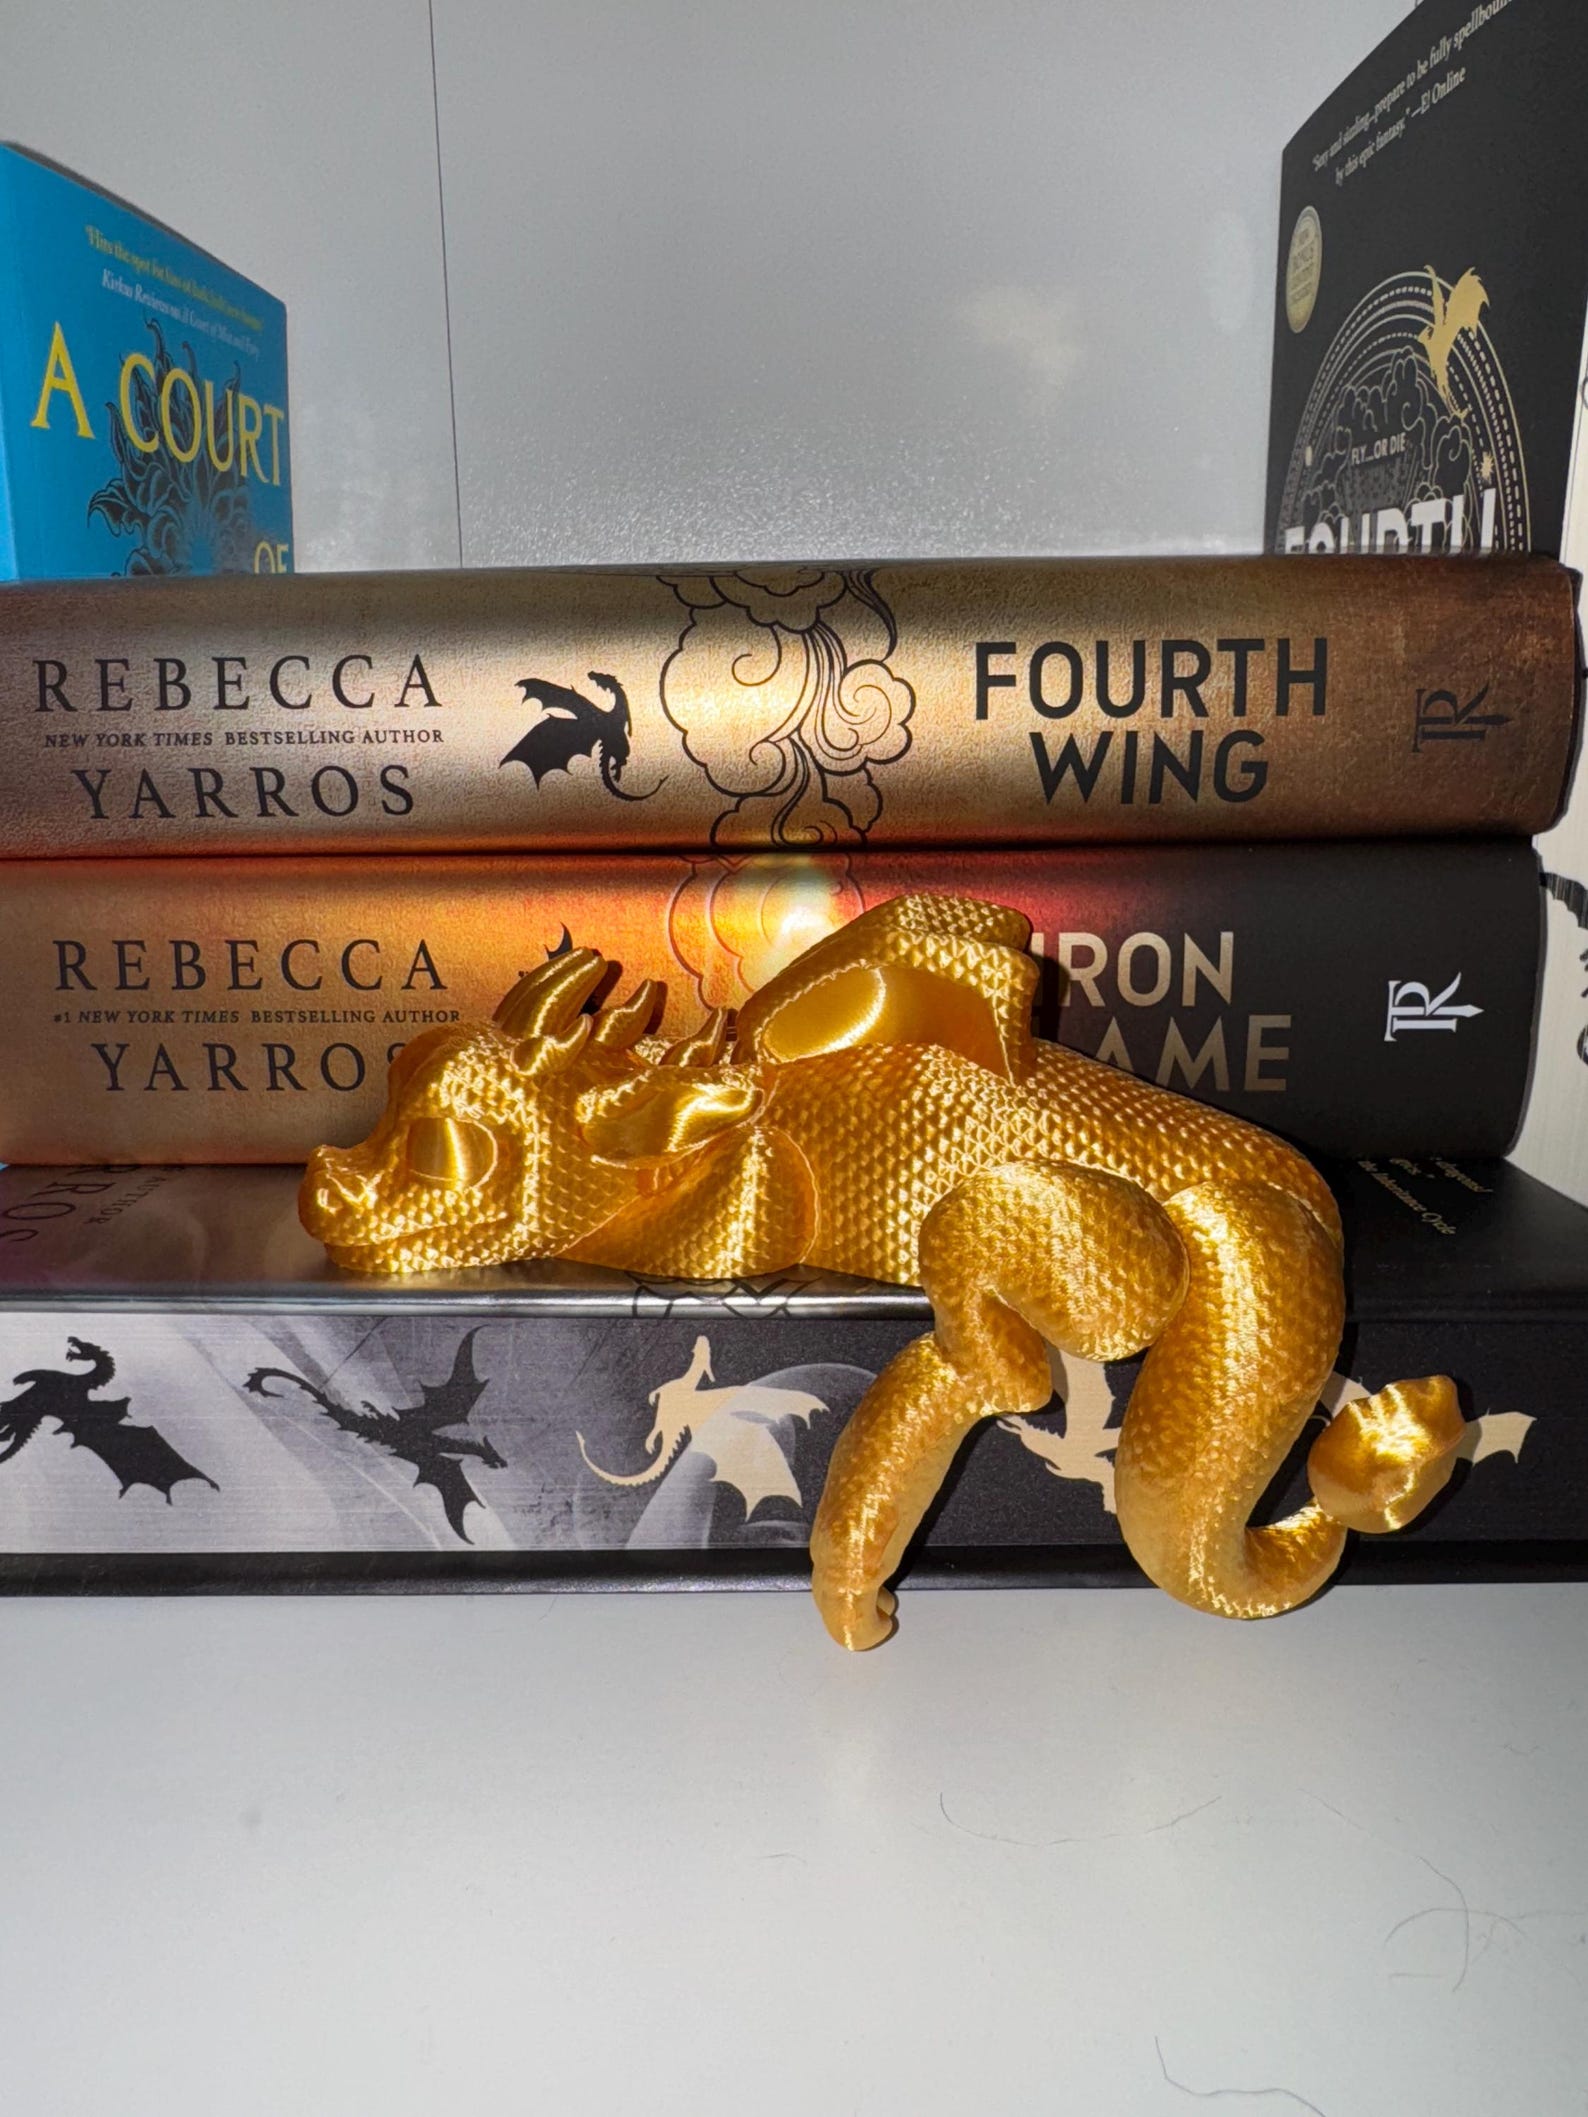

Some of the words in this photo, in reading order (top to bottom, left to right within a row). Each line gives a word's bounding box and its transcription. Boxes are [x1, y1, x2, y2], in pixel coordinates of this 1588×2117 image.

[1417, 59, 1429, 80] be
[1430, 35, 1453, 69] fully
[1432, 66, 1467, 104] Online
[30, 320, 96, 440] A
[120, 352, 285, 487] COURT
[1390, 431, 1407, 456] DIE
[254, 540, 289, 574] OF
[32, 653, 443, 713] REBECCA
[975, 637, 1328, 721] FOURTH
[45, 733, 90, 748] NEW
[96, 732, 147, 747] YORK
[153, 731, 213, 747] TIMES
[225, 730, 355, 746] BESTSELLING
[361, 729, 445, 745] AUTHOR
[70, 764, 414, 820] YARROS
[1028, 729, 1269, 806] WING
[52, 938, 448, 992] REBECCA
[1031, 930, 1234, 1008] IRON
[53, 1011, 72, 1024] #1
[78, 1010, 121, 1024] NEW
[127, 1010, 175, 1024] YORK
[182, 1010, 240, 1024] TIMES
[251, 1009, 376, 1024] BESTSELLING
[382, 1009, 461, 1024] AUTHOR
